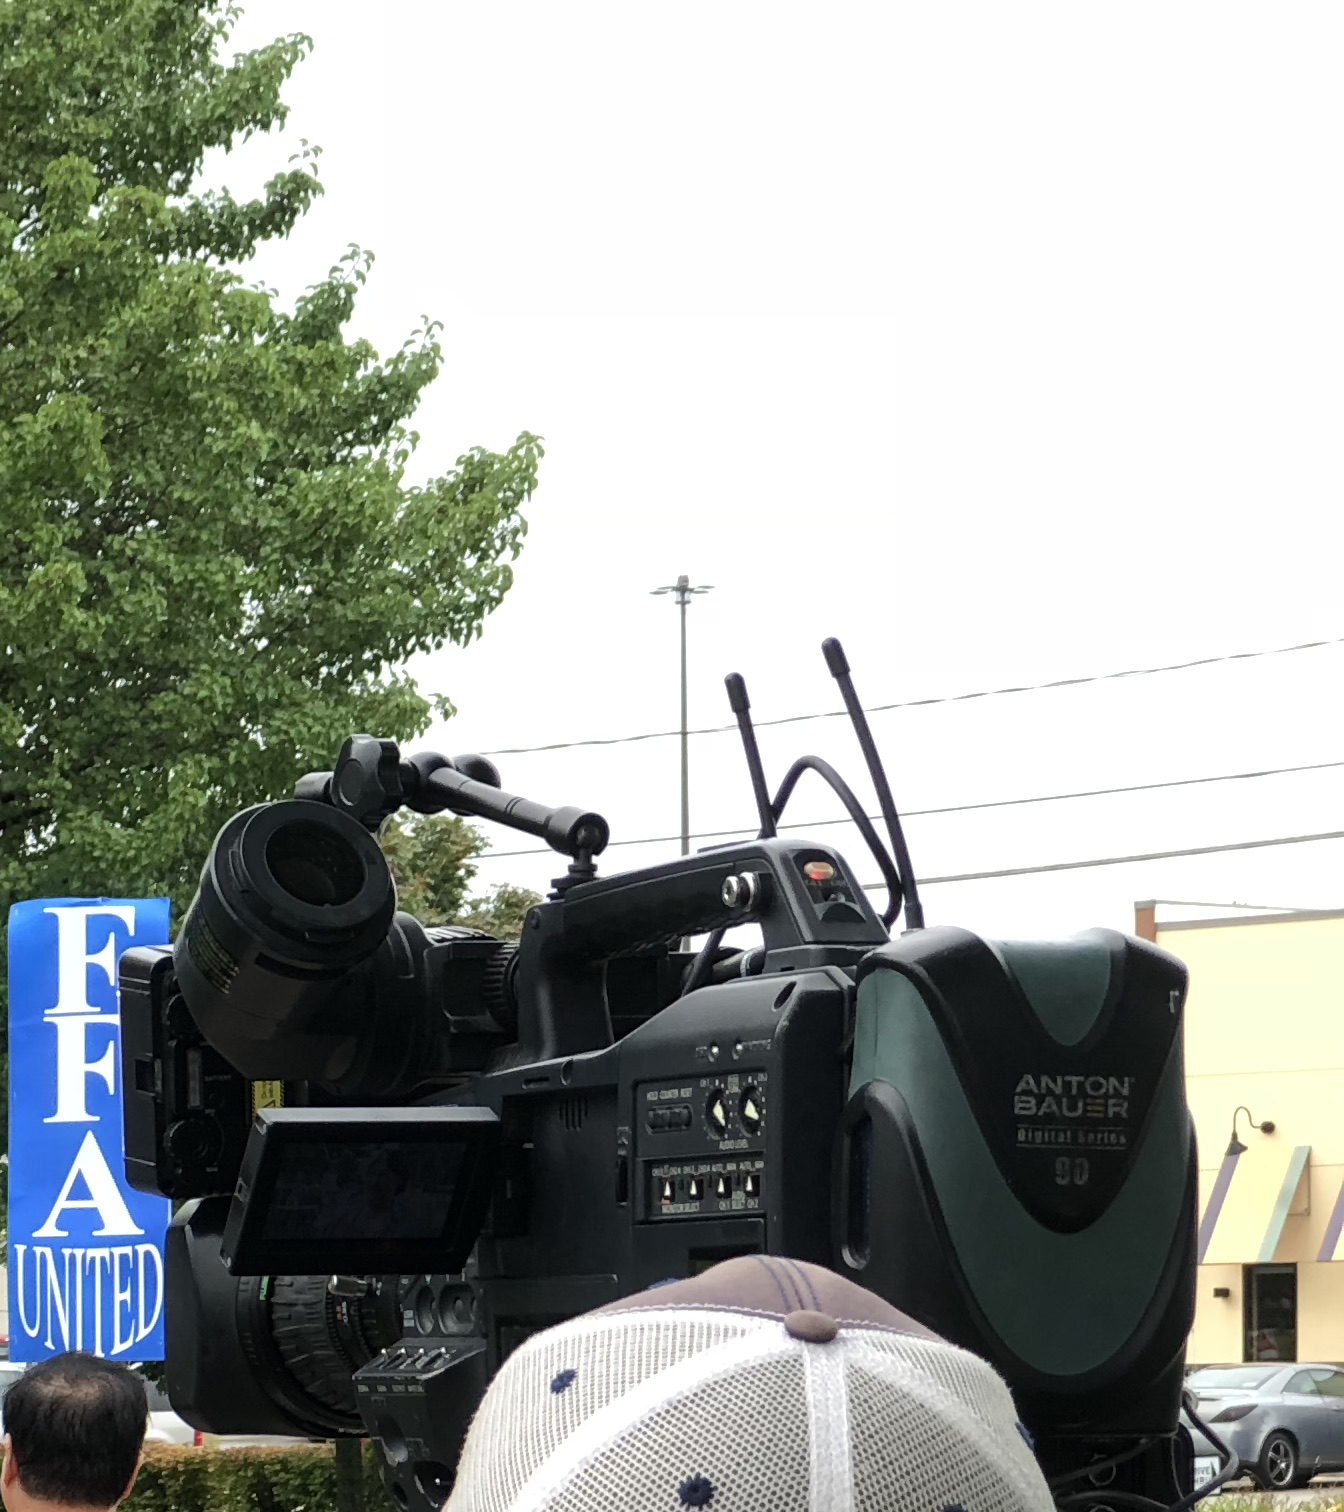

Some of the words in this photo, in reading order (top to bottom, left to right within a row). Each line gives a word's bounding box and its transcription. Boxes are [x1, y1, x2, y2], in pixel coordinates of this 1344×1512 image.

[32, 905, 145, 1237] FFA
[1015, 1074, 1130, 1096] ANTON
[1014, 1096, 1129, 1118] BAUER
[1055, 1156, 1090, 1186] 90
[13, 1243, 164, 1358] UNITED
